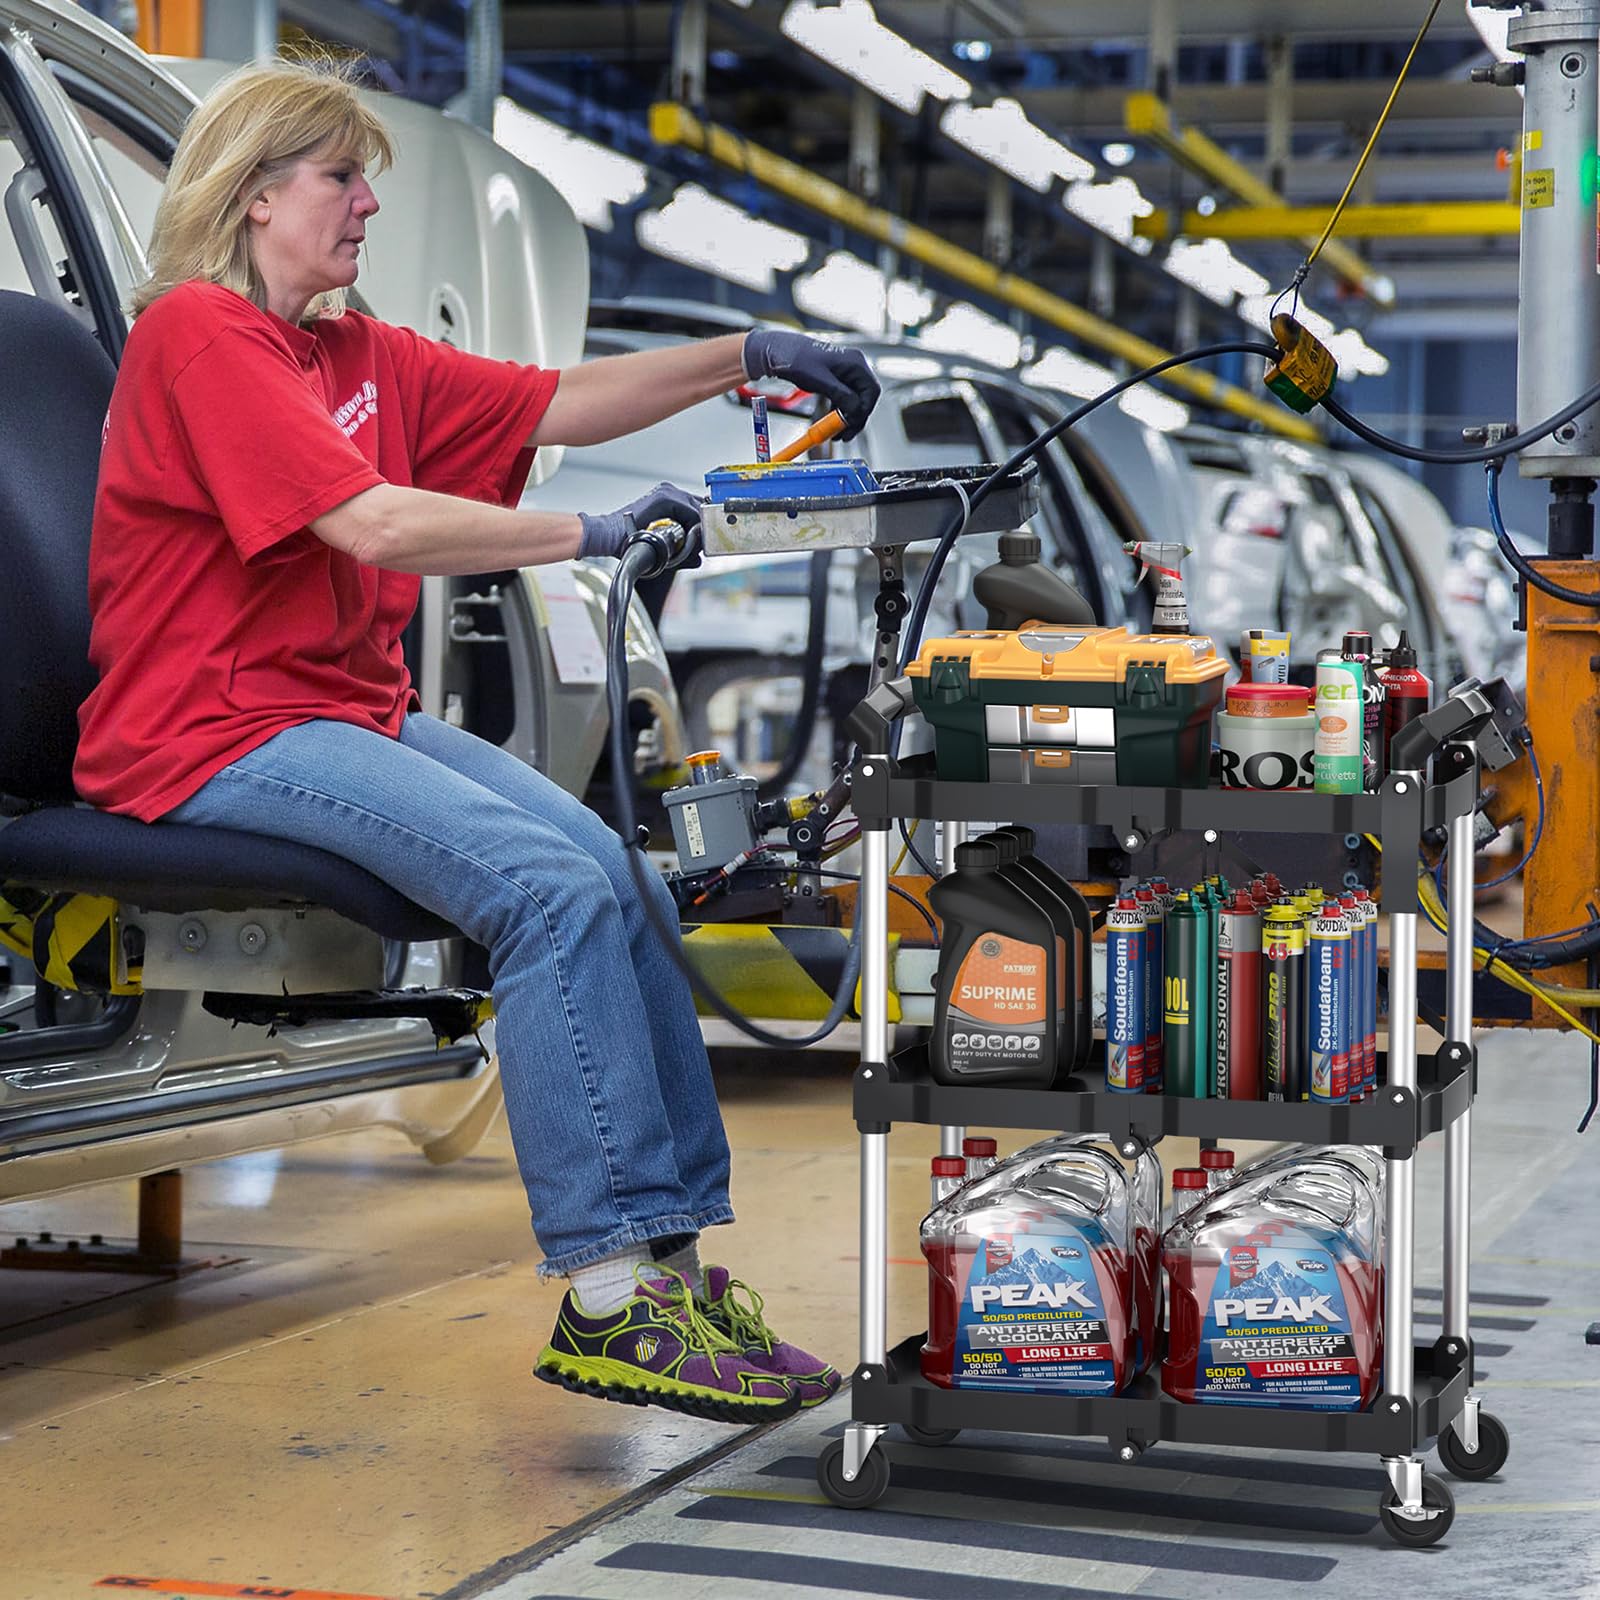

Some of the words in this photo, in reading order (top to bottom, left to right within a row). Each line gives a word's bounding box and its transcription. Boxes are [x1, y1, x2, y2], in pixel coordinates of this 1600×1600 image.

[1320, 771, 1357, 781] Cuvette
[1112, 912, 1143, 924] SOUDAL
[1316, 919, 1348, 932] SOUDAL
[1003, 964, 1037, 973] PATRIOT
[961, 985, 1037, 1001] SUPRIME
[1114, 938, 1127, 1041] Soudafoam
[1318, 946, 1332, 1051] Soudafoam
[1216, 960, 1228, 1100] PROFESSIONAL
[970, 1280, 1097, 1313] PEAK
[982, 1313, 1015, 1323] 50/50
[1017, 1311, 1083, 1321] PREDILUTED
[1213, 1295, 1343, 1327] PEAK
[976, 1321, 1100, 1335] ANTIFREEZE
[1226, 1328, 1259, 1337] 50/50
[1261, 1325, 1329, 1335] PREDILUTED
[1220, 1335, 1346, 1349] ANTIFREEZE
[962, 1353, 1003, 1364] 50/50
[1022, 1347, 1061, 1359] LONG
[1064, 1346, 1098, 1357] LIFE
[1205, 1367, 1246, 1378] 50/50
[1266, 1362, 1306, 1373] LONG
[1309, 1361, 1343, 1372] LIFE
